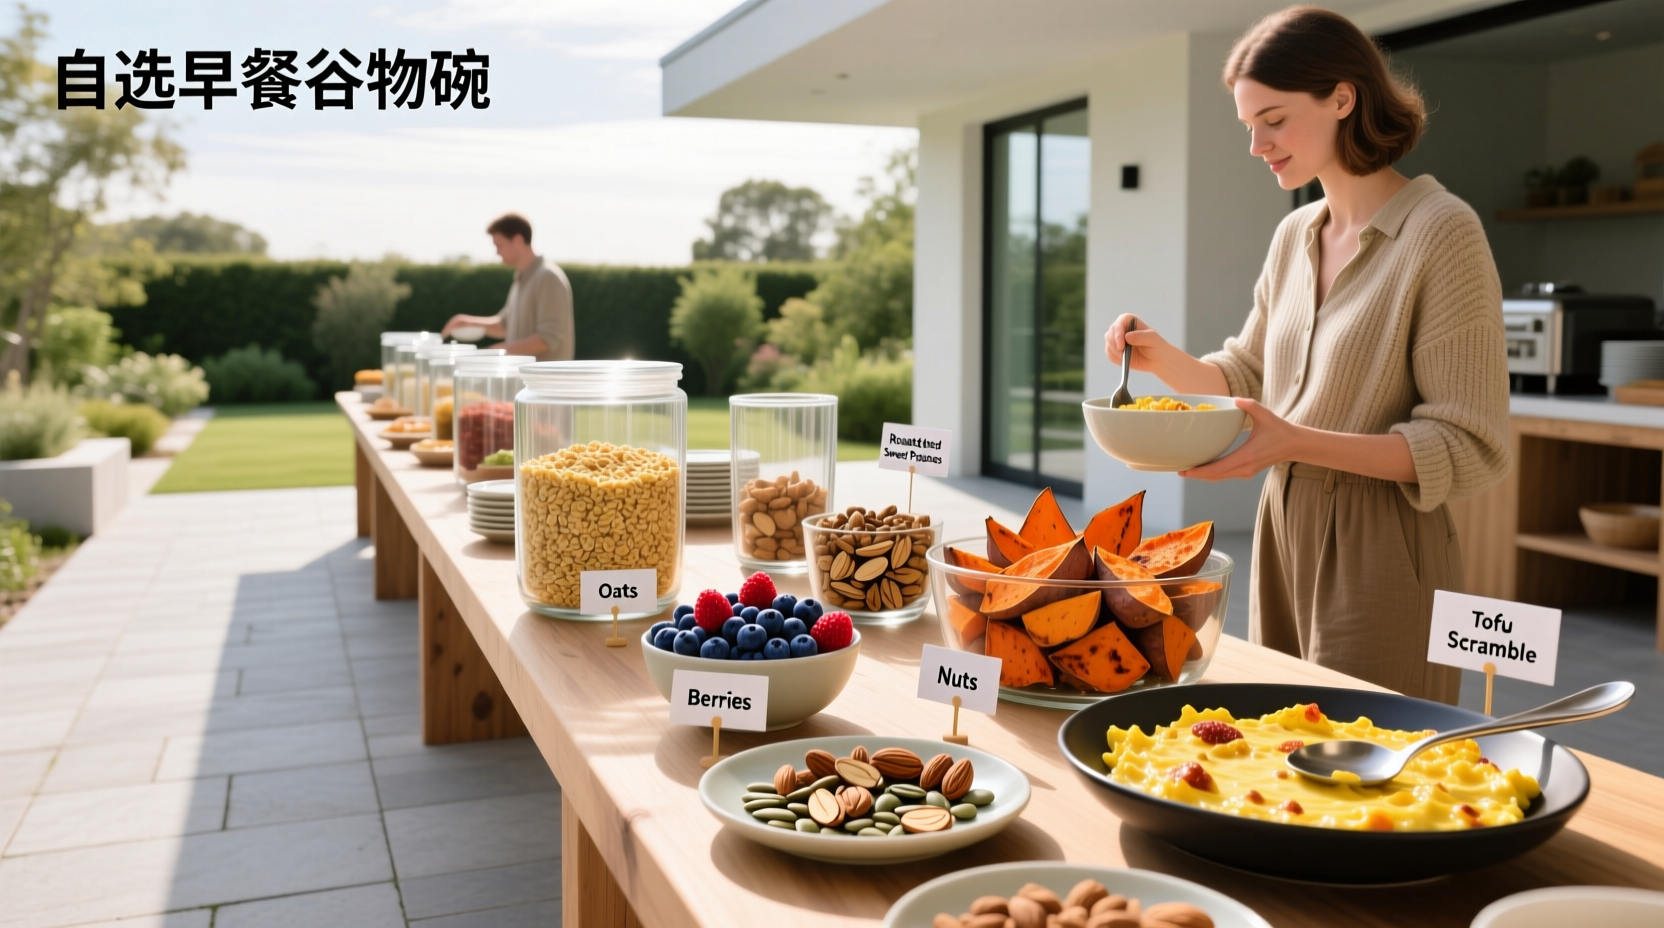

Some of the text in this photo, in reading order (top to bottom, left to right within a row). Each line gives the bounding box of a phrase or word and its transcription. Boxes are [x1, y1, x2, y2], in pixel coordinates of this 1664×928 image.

[598, 583, 639, 599] Oats
[1472, 610, 1513, 633] Tofu
[1447, 630, 1537, 663] Scramble
[937, 665, 978, 691] Nuts
[687, 688, 752, 711] Berries
